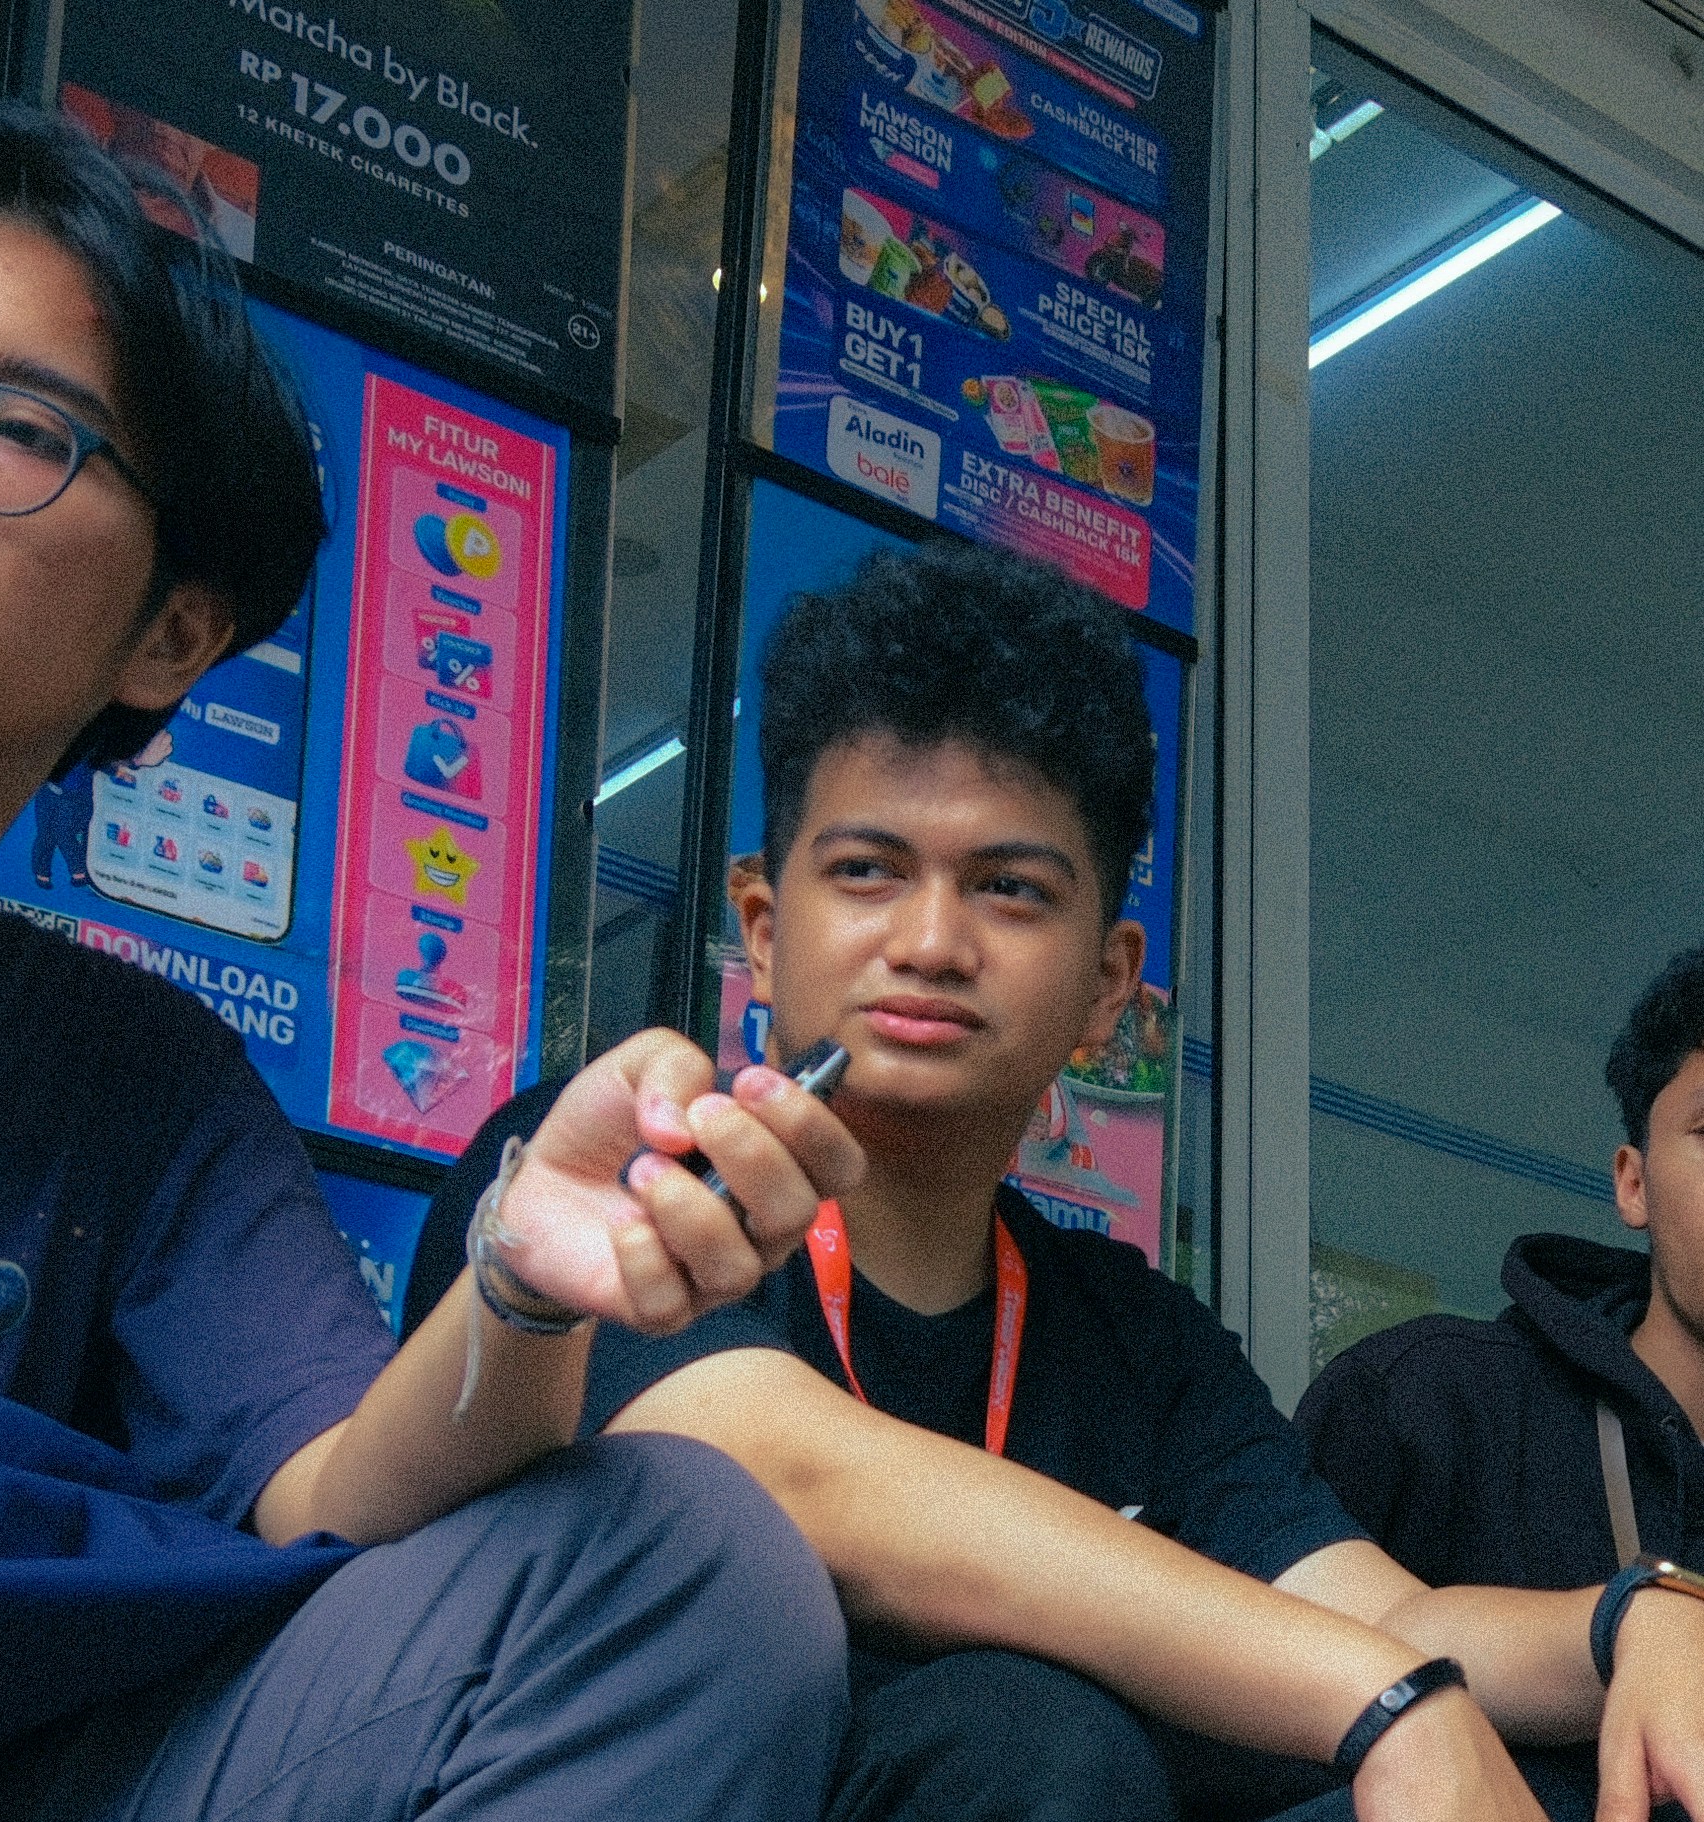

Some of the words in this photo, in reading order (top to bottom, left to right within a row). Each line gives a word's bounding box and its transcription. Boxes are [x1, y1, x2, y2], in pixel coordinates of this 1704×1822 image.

[996, 14, 1048, 61] EDITION
[1085, 24, 1155, 82] REWARDS
[240, 50, 282, 85] RP
[290, 72, 471, 186] 17.000
[383, 45, 430, 101] by
[436, 72, 540, 149] Black.
[861, 91, 953, 153] LAWSON
[1030, 93, 1124, 156] CASHBACK
[859, 110, 952, 173] MISSION
[1077, 101, 1158, 157] VOUCHER
[237, 104, 259, 125] 12
[265, 116, 344, 162] KRETEK
[350, 154, 471, 219] CIGARETTES
[383, 240, 497, 301] PERINGATAN:
[846, 302, 907, 349] BUY
[908, 334, 923, 359] 1
[1038, 293, 1107, 345] PRICE
[1055, 281, 1152, 346] SPECIAL
[844, 332, 904, 379] GET
[907, 363, 921, 389] 1
[387, 427, 422, 457] MY
[423, 415, 500, 463] FITUR
[844, 415, 925, 460] Aladin
[959, 471, 1001, 503] DISC
[1018, 496, 1109, 553] CASHBACK
[961, 450, 1040, 504] EXTRA
[1045, 489, 1141, 548] BENEFIT
[211, 708, 275, 739] LAWSON
[84, 926, 299, 1011] DOWNLOAD
